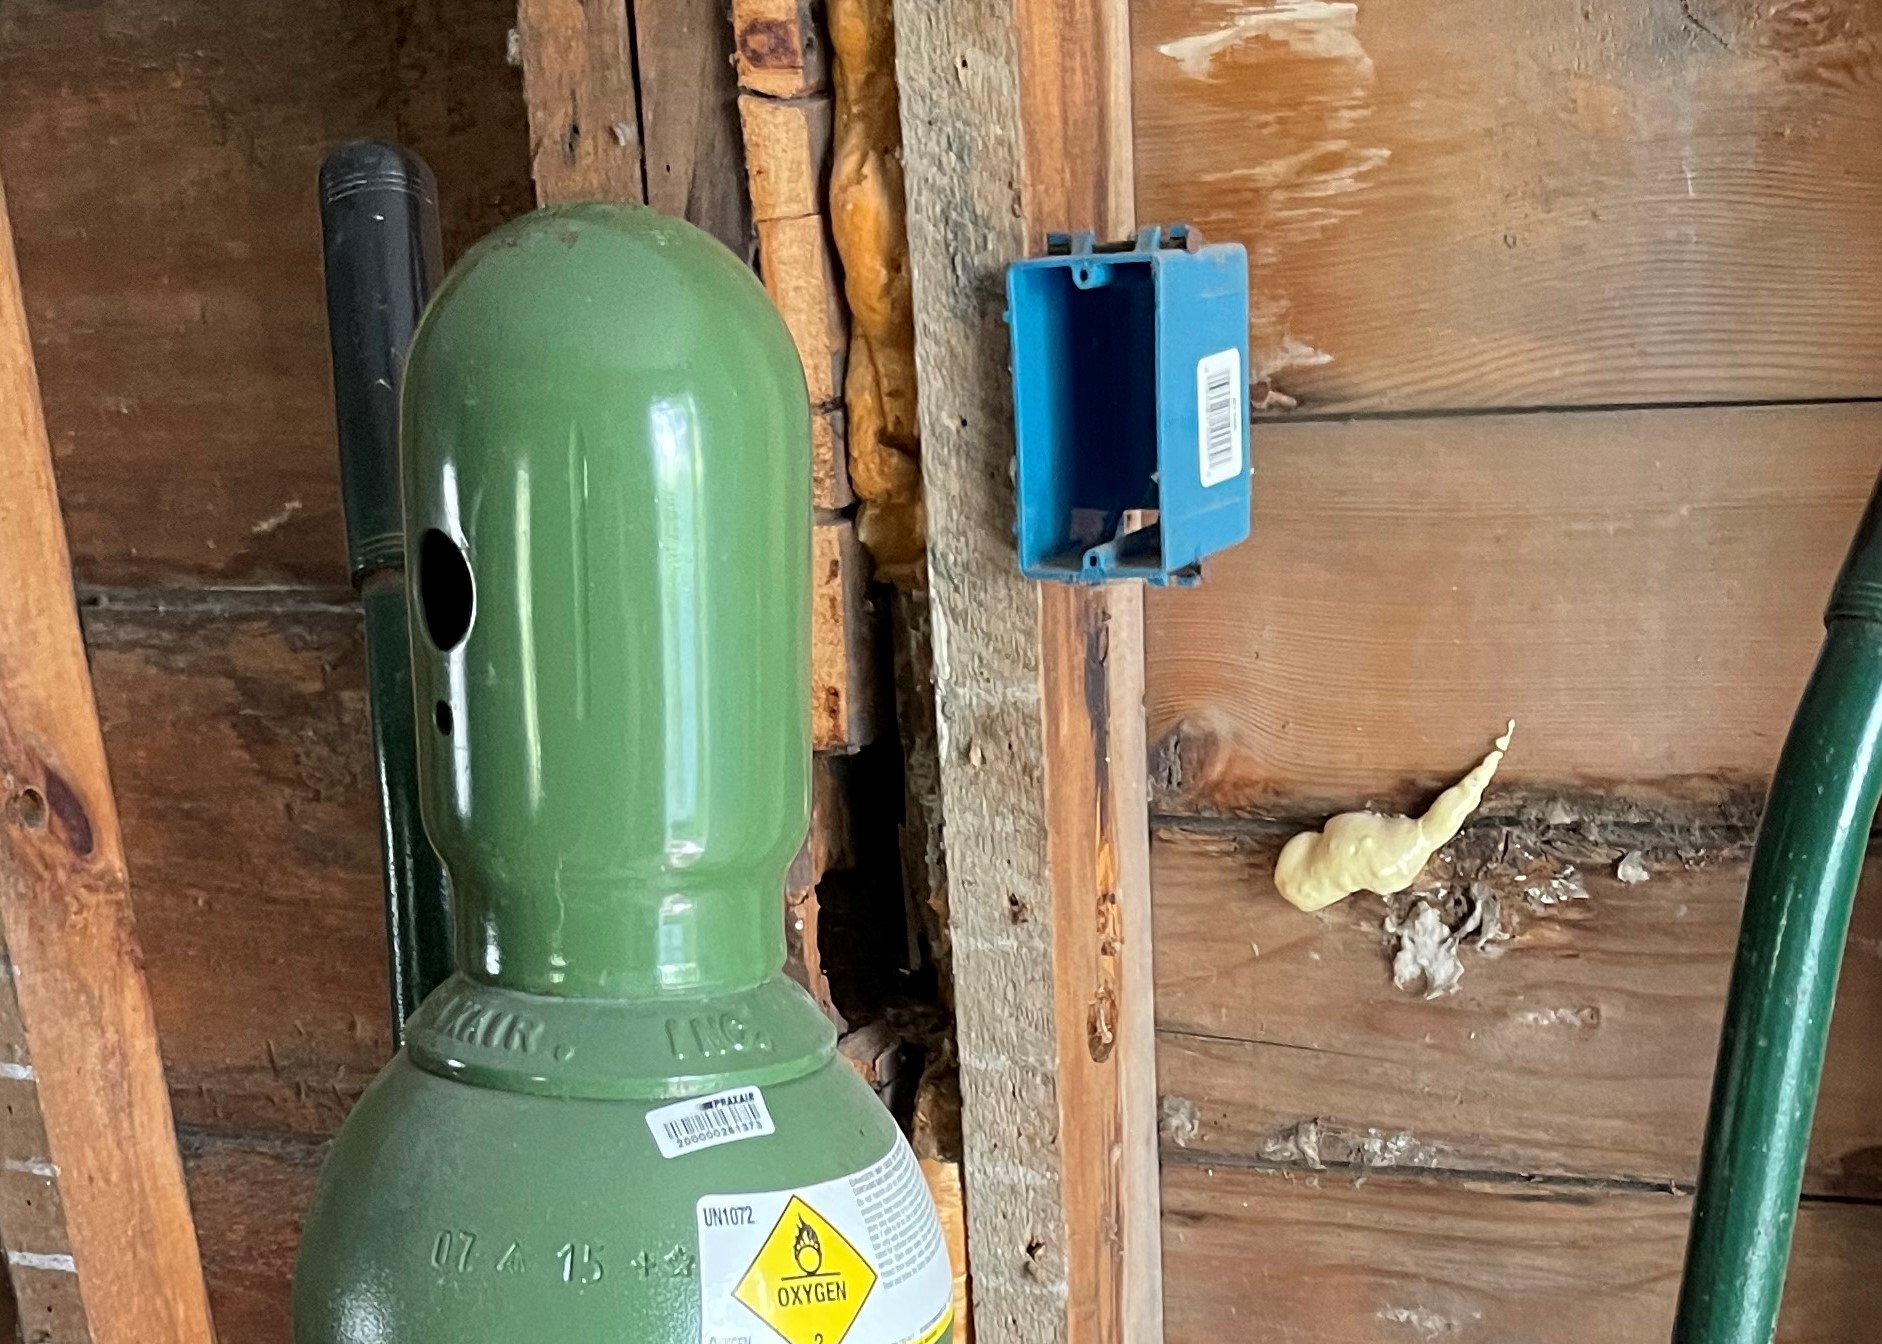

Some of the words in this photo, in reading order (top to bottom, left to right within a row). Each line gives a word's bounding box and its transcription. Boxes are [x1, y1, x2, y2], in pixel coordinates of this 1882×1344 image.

[713, 1091, 755, 1108] PRAXAIR
[703, 1206, 755, 1227] UN1072
[777, 1281, 848, 1308] OXYGEN
